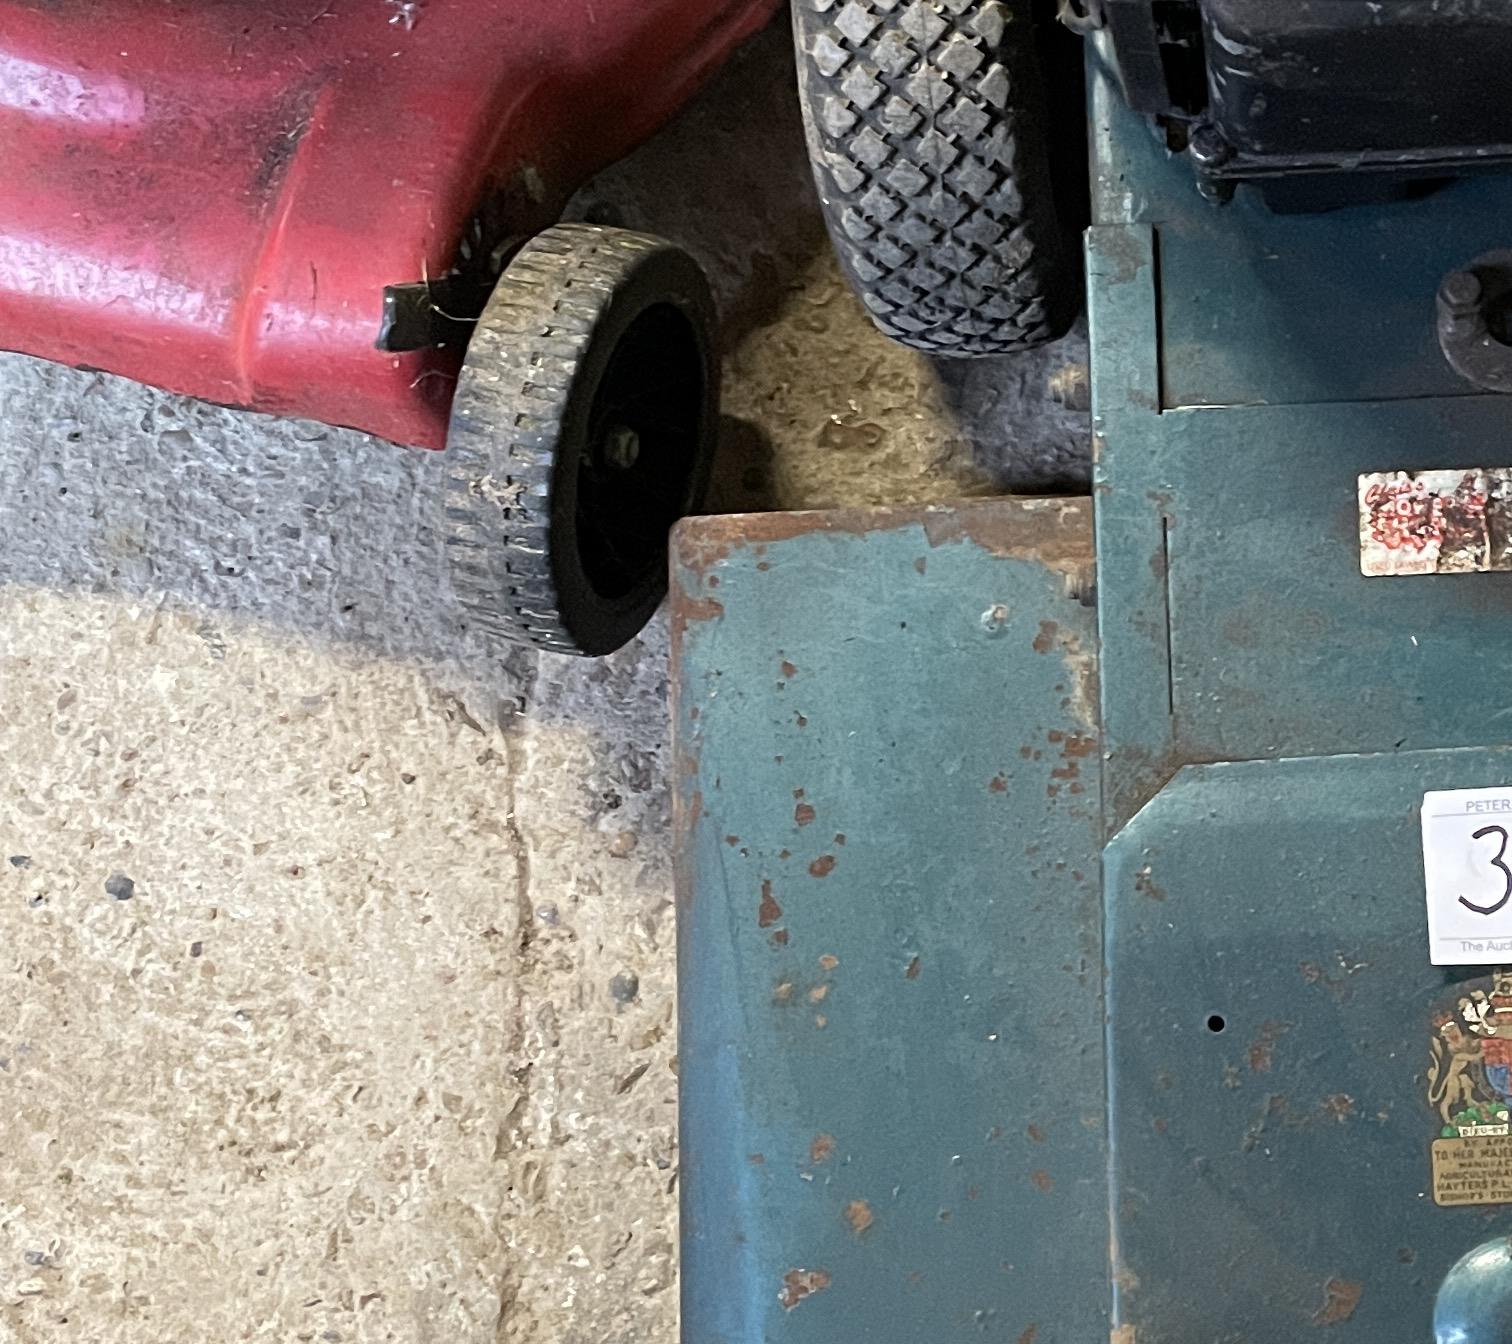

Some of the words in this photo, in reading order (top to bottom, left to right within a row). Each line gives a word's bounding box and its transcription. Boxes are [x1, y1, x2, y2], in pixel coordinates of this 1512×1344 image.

[1466, 799, 1510, 812] PETER
[1461, 941, 1483, 952] The
[1435, 1150, 1448, 1160] TO
[1453, 1148, 1474, 1159] HER
[1437, 1180, 1488, 1192] HAYTERS
